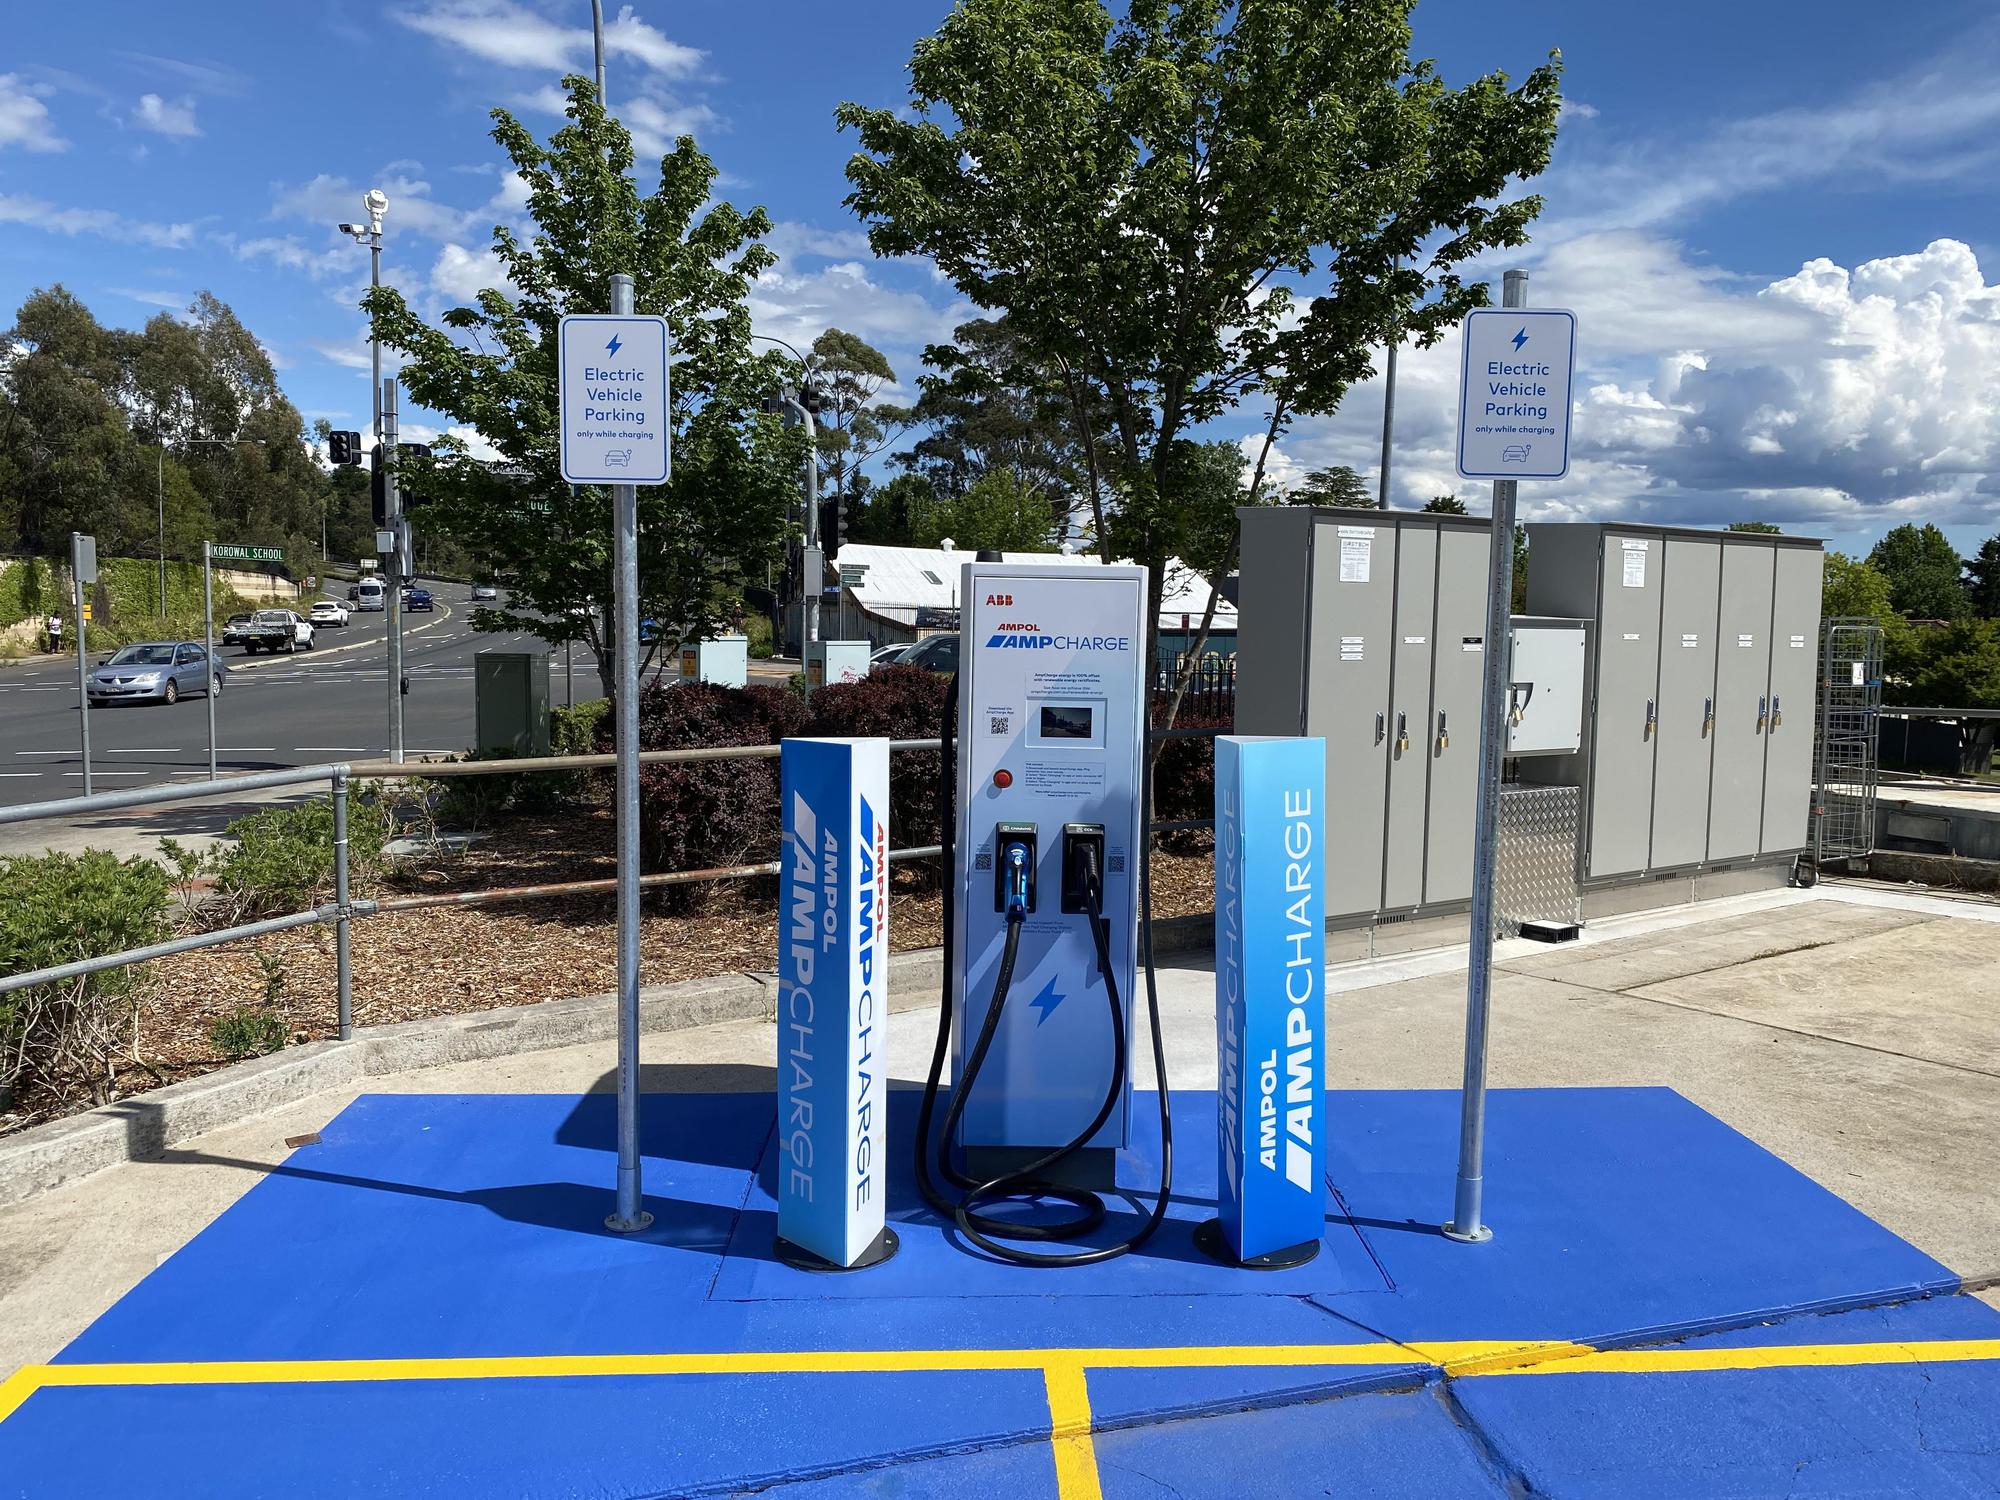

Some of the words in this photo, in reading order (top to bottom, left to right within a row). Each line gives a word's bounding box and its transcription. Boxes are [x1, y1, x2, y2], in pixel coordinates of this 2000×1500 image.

[584, 368, 644, 382] Electric
[1488, 362, 1550, 376] Electric
[586, 388, 642, 402] Vehicle
[1488, 382, 1546, 396] Vehicle
[585, 408, 645, 424] Parking
[1486, 402, 1548, 420] Parking
[576, 430, 594, 438] only
[595, 430, 617, 438] while
[618, 430, 654, 440] charging
[1475, 426, 1492, 434] only
[1494, 425, 1517, 433] while
[1518, 426, 1555, 436] charging
[213, 545, 250, 558] KOROWAL
[253, 548, 283, 560] SCHOOL
[986, 594, 1014, 606] ABB
[997, 623, 1040, 632] AMPOL
[1003, 634, 1128, 651] AMPCHARGE
[876, 822, 885, 942] AMPOL
[823, 828, 838, 953] AMPOL
[1224, 788, 1237, 1141] AMPCHARGE
[1285, 788, 1312, 1146] AMPCHARGE
[789, 855, 816, 1204] AMPCHARGE
[855, 859, 873, 1212] AMPCHARGE
[1260, 1049, 1276, 1171] AMPOL
